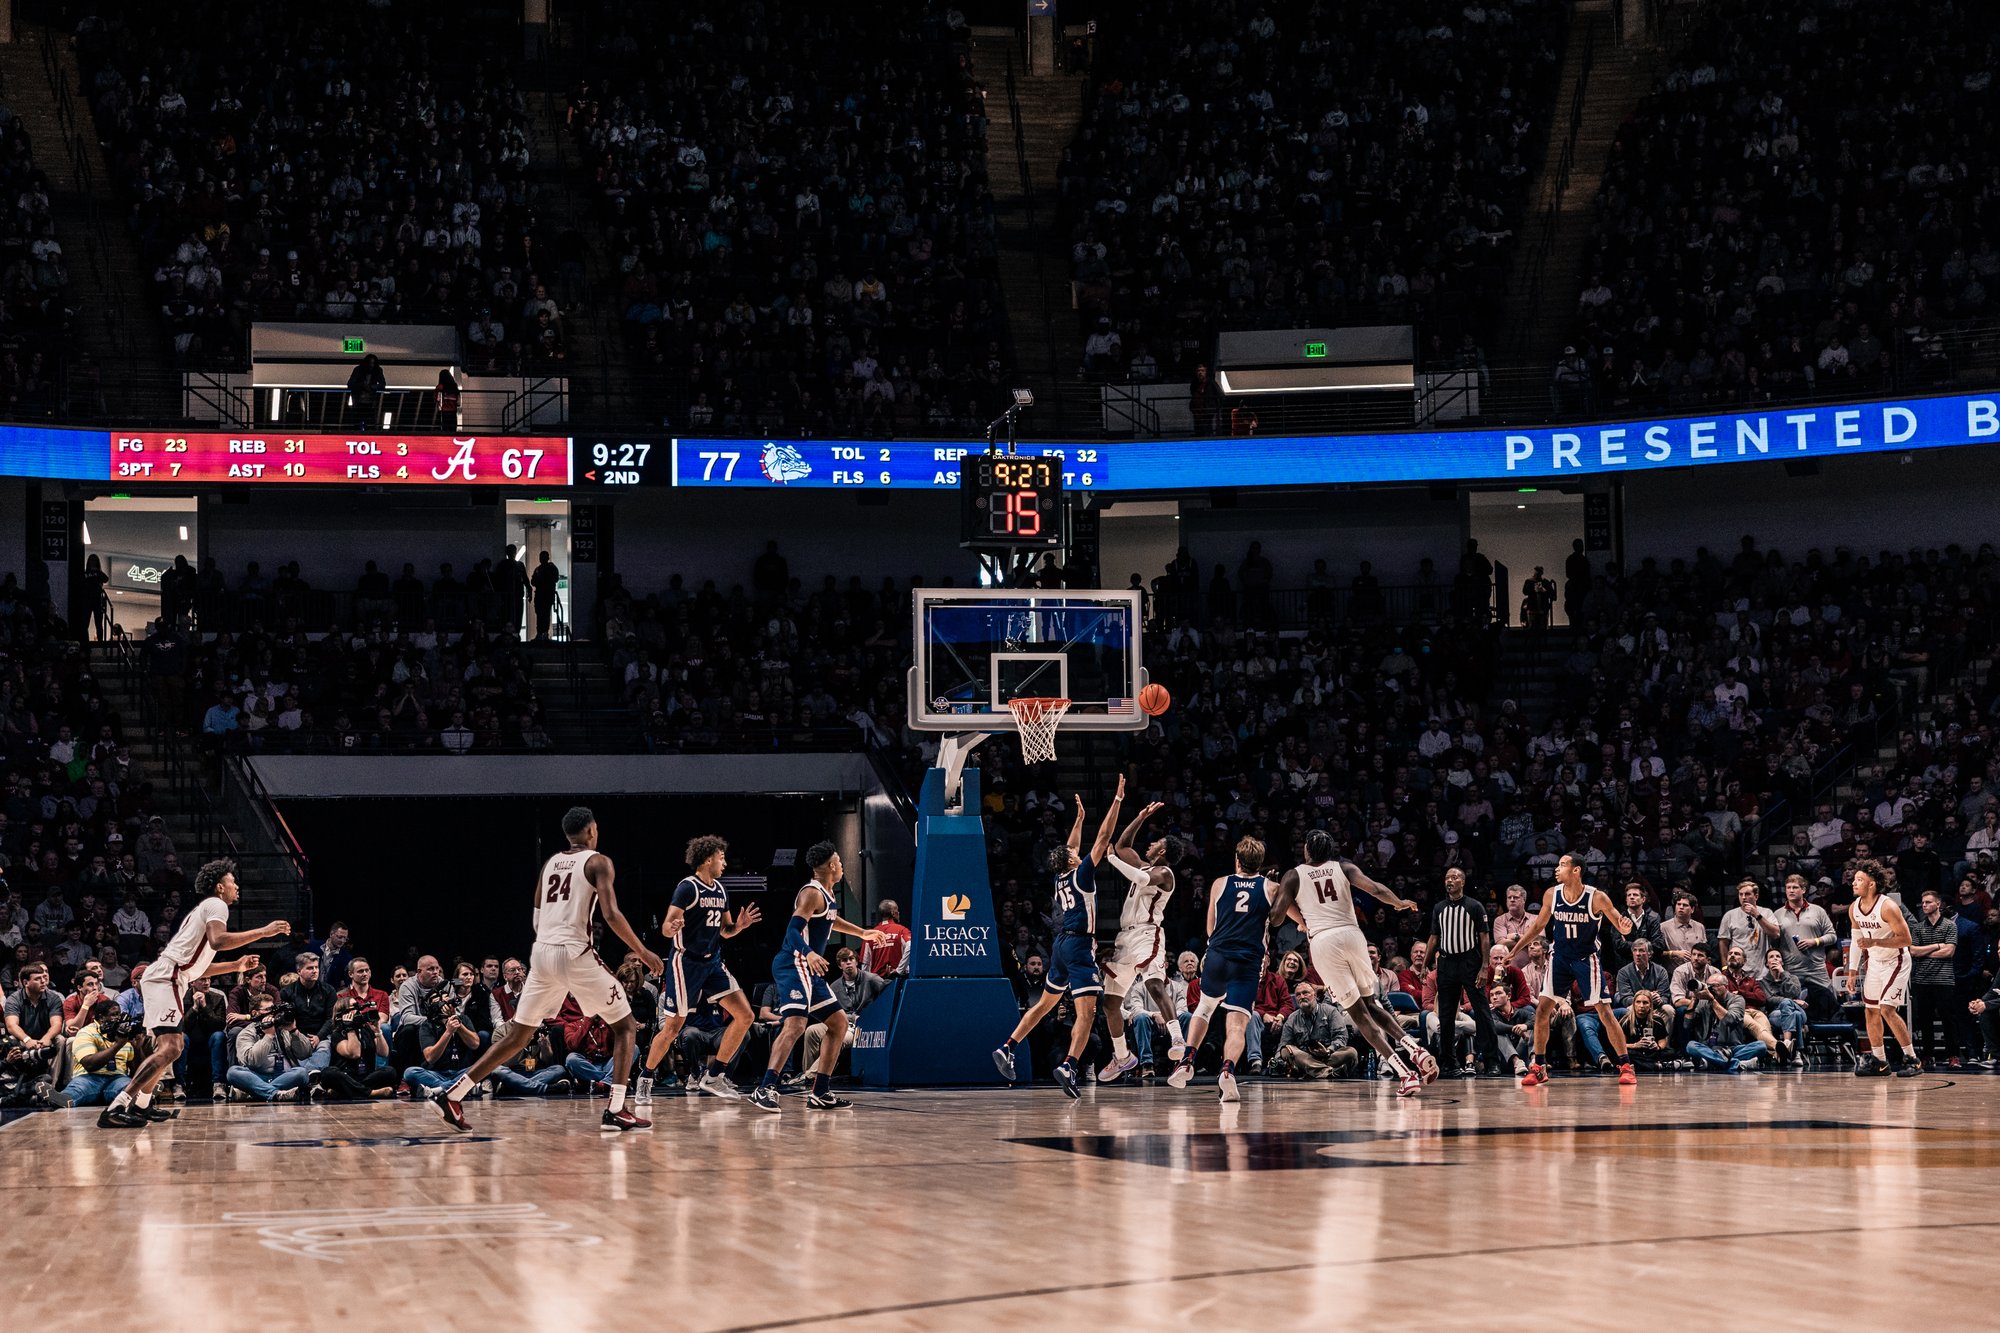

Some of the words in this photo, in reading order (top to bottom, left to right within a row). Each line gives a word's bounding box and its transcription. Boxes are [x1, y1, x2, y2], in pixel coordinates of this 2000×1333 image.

[1505, 406, 1918, 470] PRESENTED
[1967, 400, 2000, 438] B
[119, 438, 144, 452] FG
[165, 439, 187, 452] 23
[229, 440, 266, 454] REB
[284, 440, 304, 453] 31
[346, 441, 381, 455] TOL
[396, 443, 408, 456] 3
[592, 443, 651, 467] 9:27
[831, 447, 866, 460] TOL
[879, 448, 891, 462] 2
[1077, 450, 1097, 463] 32
[118, 463, 153, 476] 3PT
[170, 463, 182, 477] 7
[228, 464, 265, 477] AST
[283, 463, 305, 477] 10
[347, 465, 380, 479] FLS
[396, 465, 409, 479] 4
[501, 448, 545, 480] 67
[699, 452, 741, 482] 77
[603, 471, 640, 485] 2ND
[832, 471, 864, 485] FLS
[880, 471, 891, 485] 6
[995, 463, 1050, 488] 9:27
[1081, 473, 1093, 486] 6
[44, 515, 66, 525] 120
[1006, 491, 1040, 535] 15
[576, 519, 593, 528] 121
[45, 538, 64, 547] 121
[575, 540, 594, 549] 122
[546, 872, 572, 903] 24
[1233, 881, 1257, 889] TIMME
[1313, 878, 1339, 904] 14
[1234, 890, 1250, 913] 2
[706, 910, 721, 927] 22
[1554, 910, 1590, 923] GONZAGA
[924, 924, 991, 941] LEGACY
[1564, 923, 1578, 939] 11
[928, 943, 988, 957] ARENA
